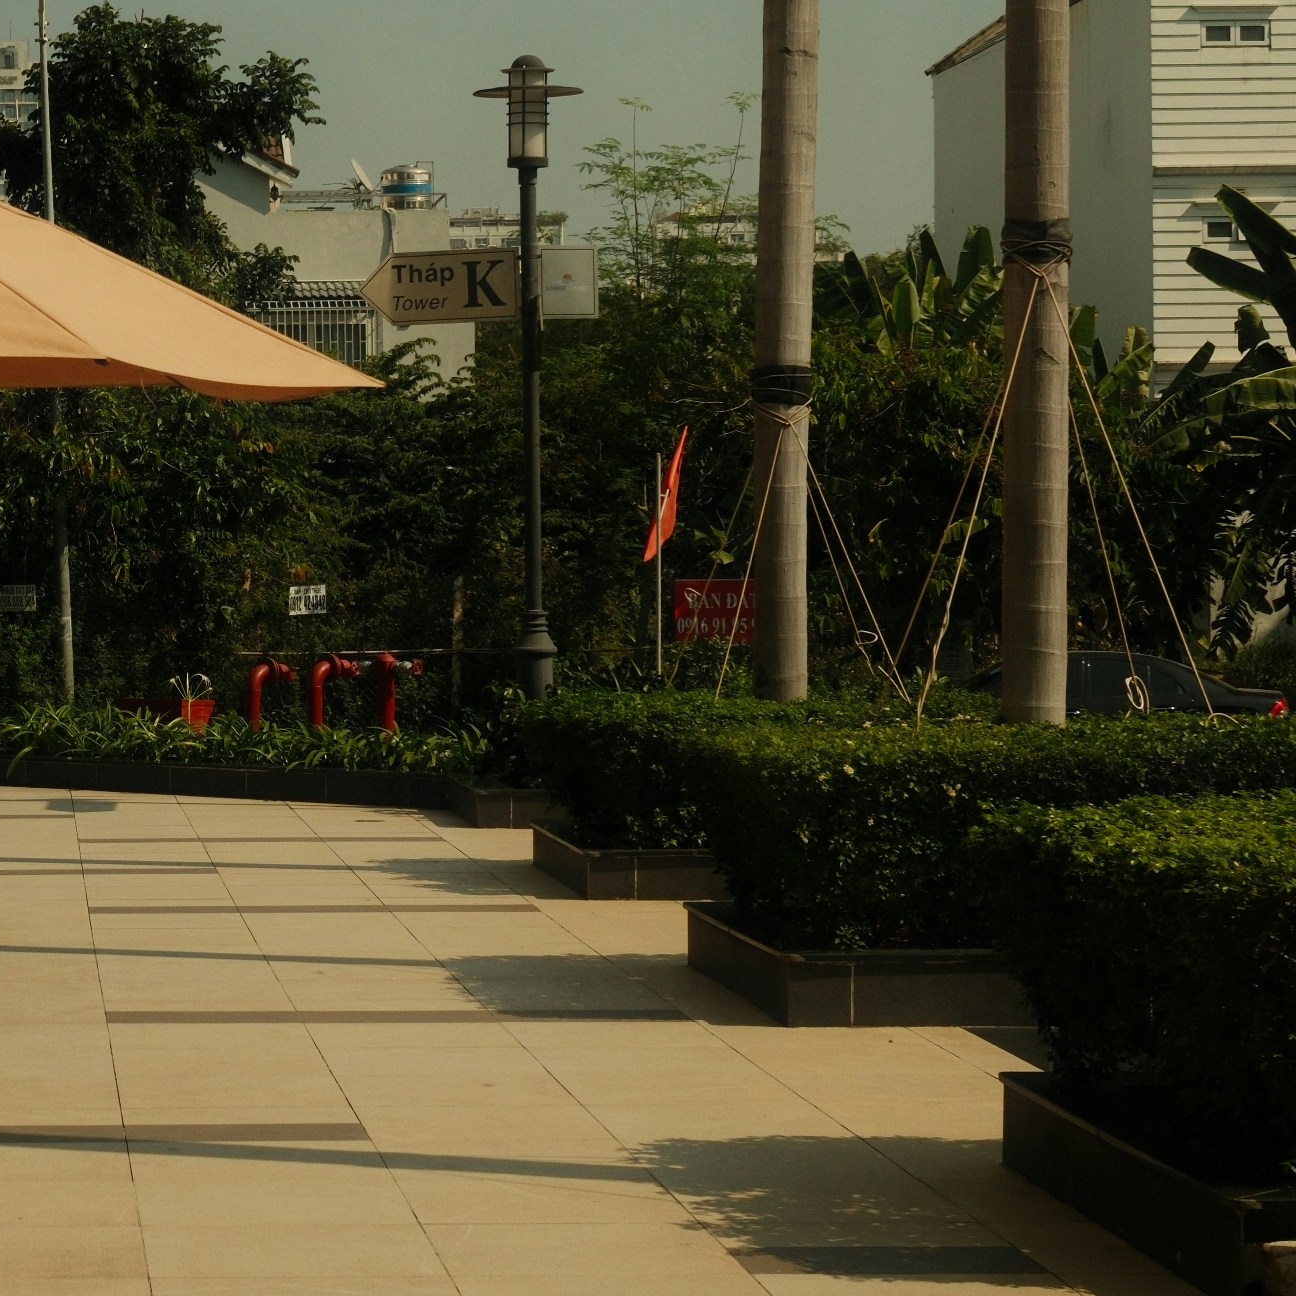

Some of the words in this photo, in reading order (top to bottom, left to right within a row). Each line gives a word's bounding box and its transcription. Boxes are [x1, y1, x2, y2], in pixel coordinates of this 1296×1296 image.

[391, 262, 455, 287] Tháp
[461, 259, 508, 308] K
[392, 295, 450, 312] Tower
[677, 617, 709, 634] 0916
[712, 617, 727, 634] 91
